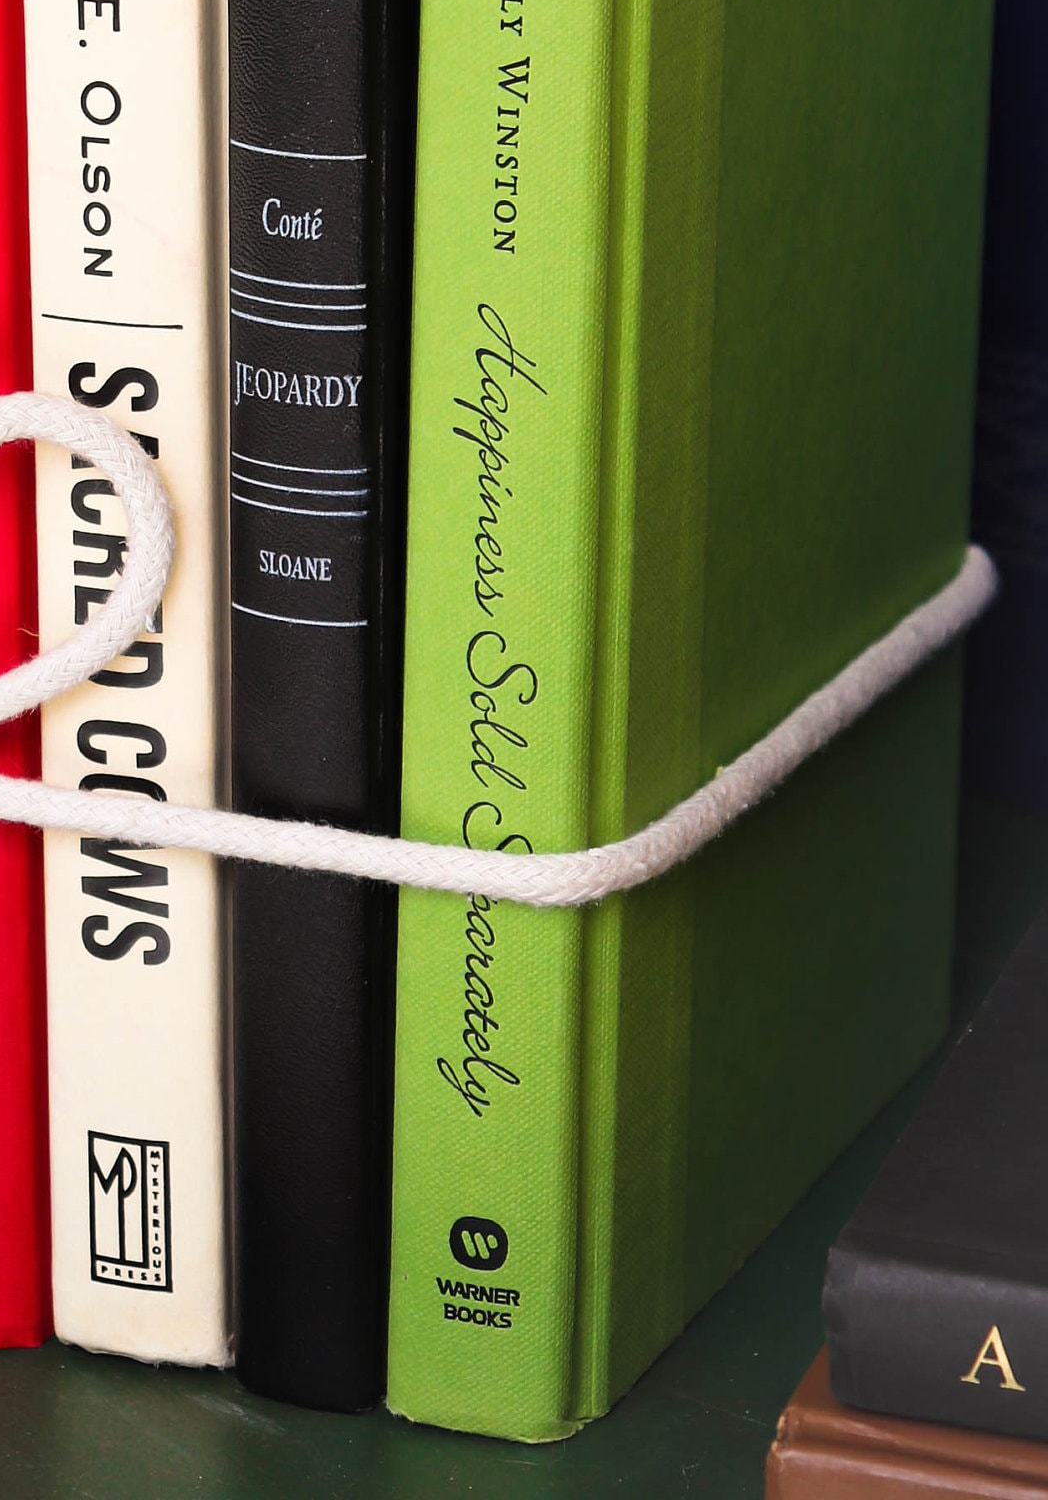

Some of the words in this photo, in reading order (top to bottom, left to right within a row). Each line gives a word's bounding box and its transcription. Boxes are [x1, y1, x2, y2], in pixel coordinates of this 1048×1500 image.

[80, 80, 122, 278] OLSON
[493, 56, 531, 255] WINSTON
[261, 197, 323, 241] Conté
[233, 360, 363, 407] JEOPARDY
[452, 303, 548, 618] Happiness
[259, 549, 333, 582] SLOANE
[466, 630, 538, 790] Sold
[149, 1150, 162, 1283] MYSTERIOUS
[100, 1265, 149, 1282] PRESS
[436, 1276, 521, 1307] WARNER
[443, 1302, 512, 1329] BOOKS
[960, 1324, 1027, 1393] A
